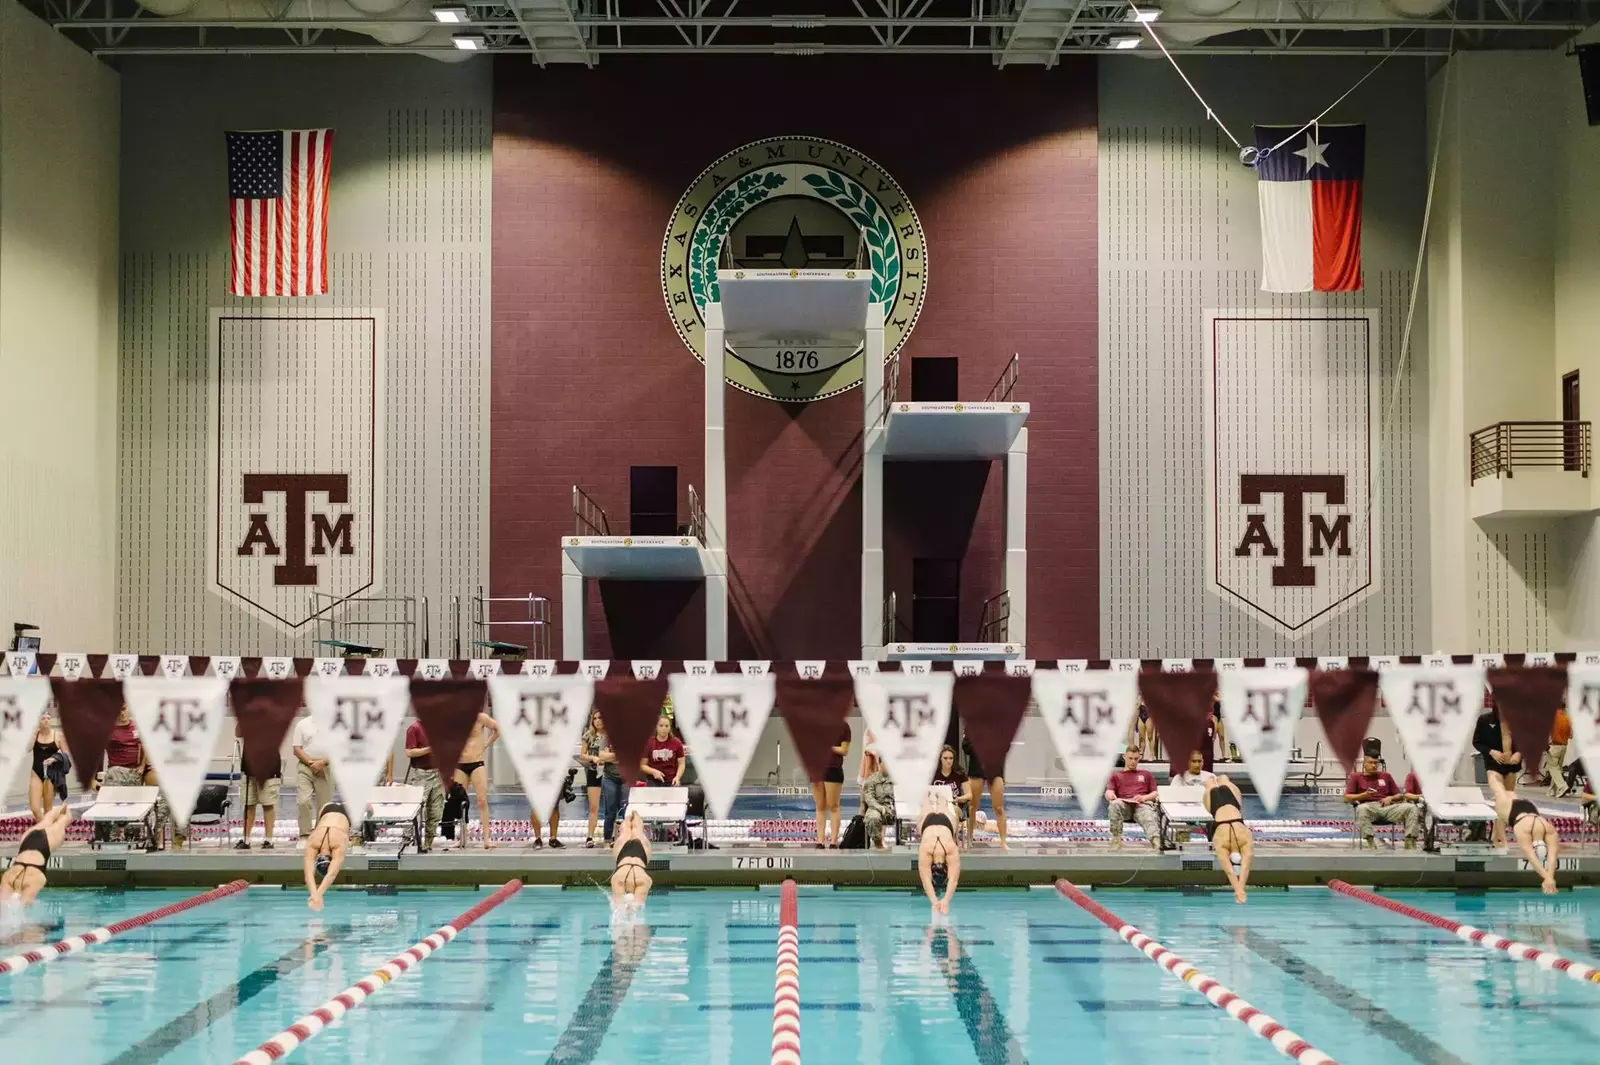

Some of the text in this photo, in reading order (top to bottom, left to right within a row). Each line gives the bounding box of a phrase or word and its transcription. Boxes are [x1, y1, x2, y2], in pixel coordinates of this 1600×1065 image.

[669, 203, 698, 333] TEXAS
[807, 145, 920, 333] UNIVERSITY
[775, 350, 819, 369] 1876
[737, 857, 744, 869] 7
[748, 857, 761, 869] FT
[780, 857, 791, 869] IN
[1522, 859, 1529, 870] 7
[1566, 858, 1577, 870] IN
